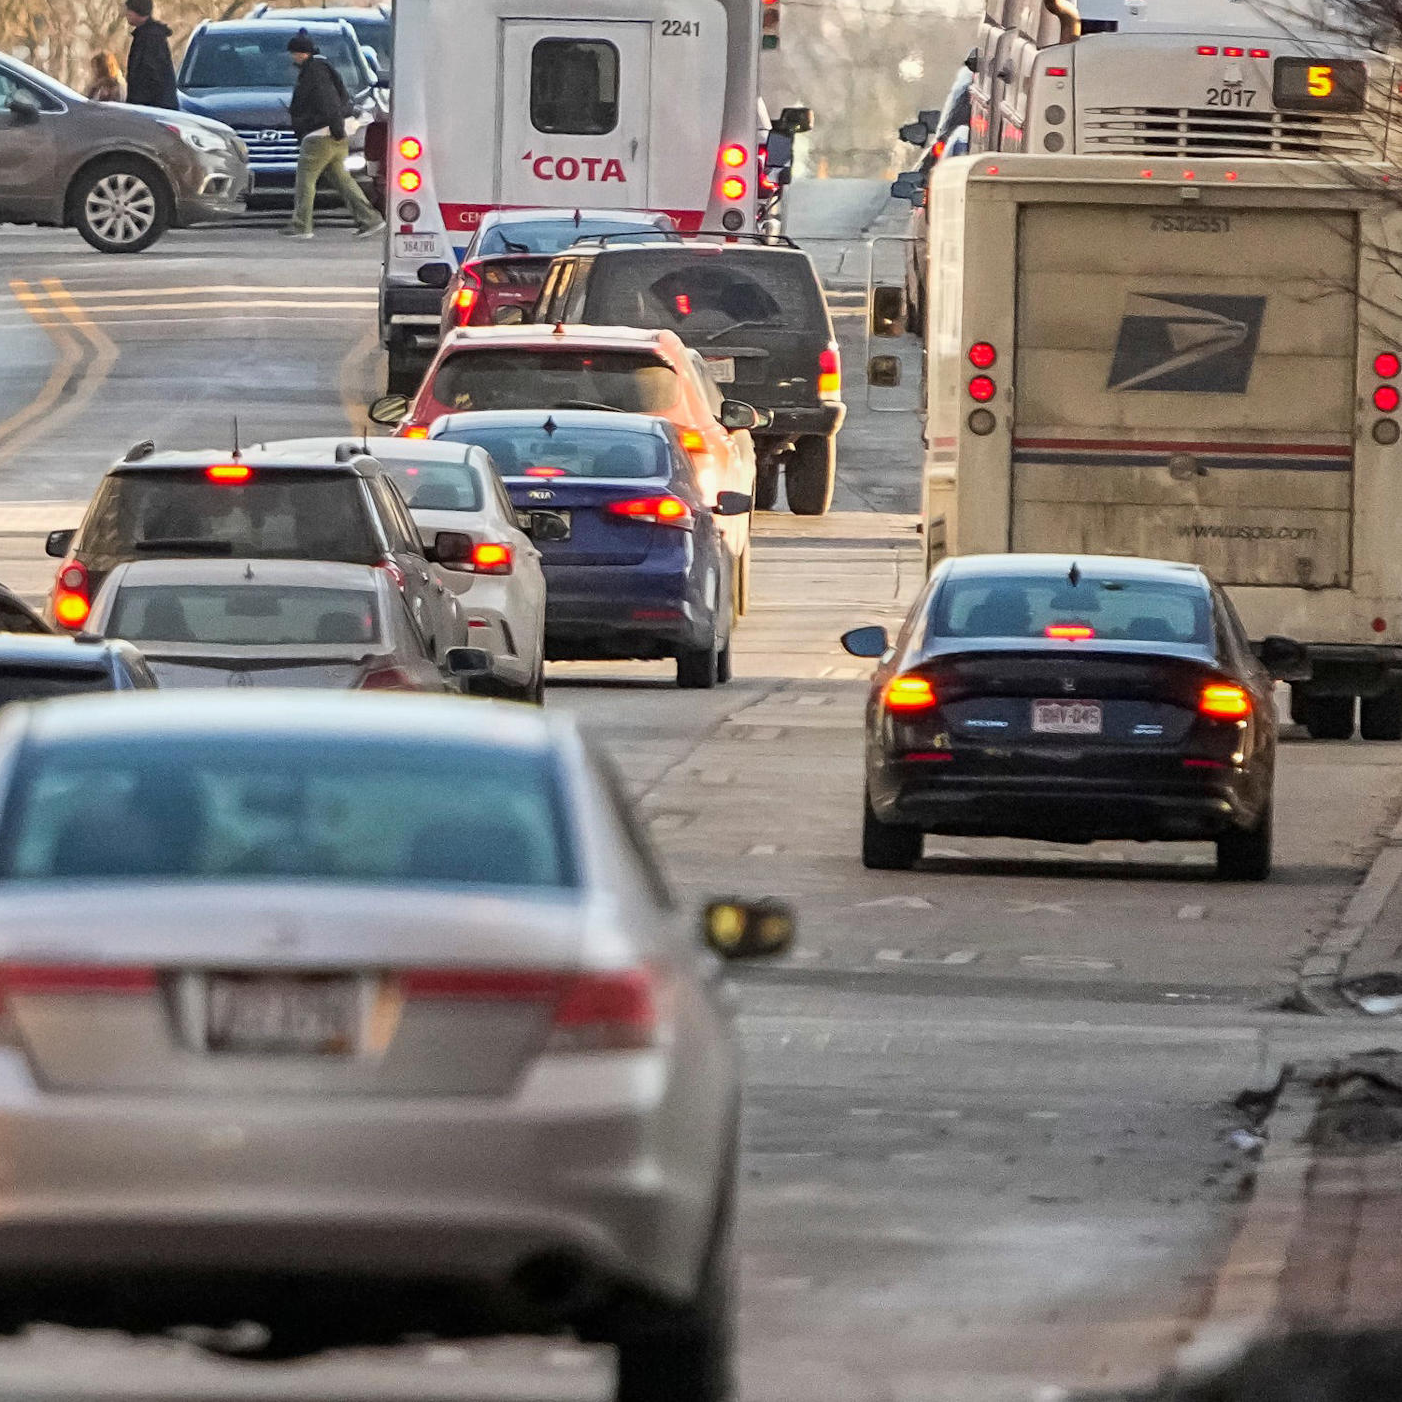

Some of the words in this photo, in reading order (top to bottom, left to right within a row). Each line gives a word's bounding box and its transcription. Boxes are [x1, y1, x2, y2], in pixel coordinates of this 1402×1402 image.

[661, 20, 701, 38] 2241
[1308, 66, 1335, 97] 5
[1206, 88, 1257, 107] 2017
[533, 156, 627, 182] COTA
